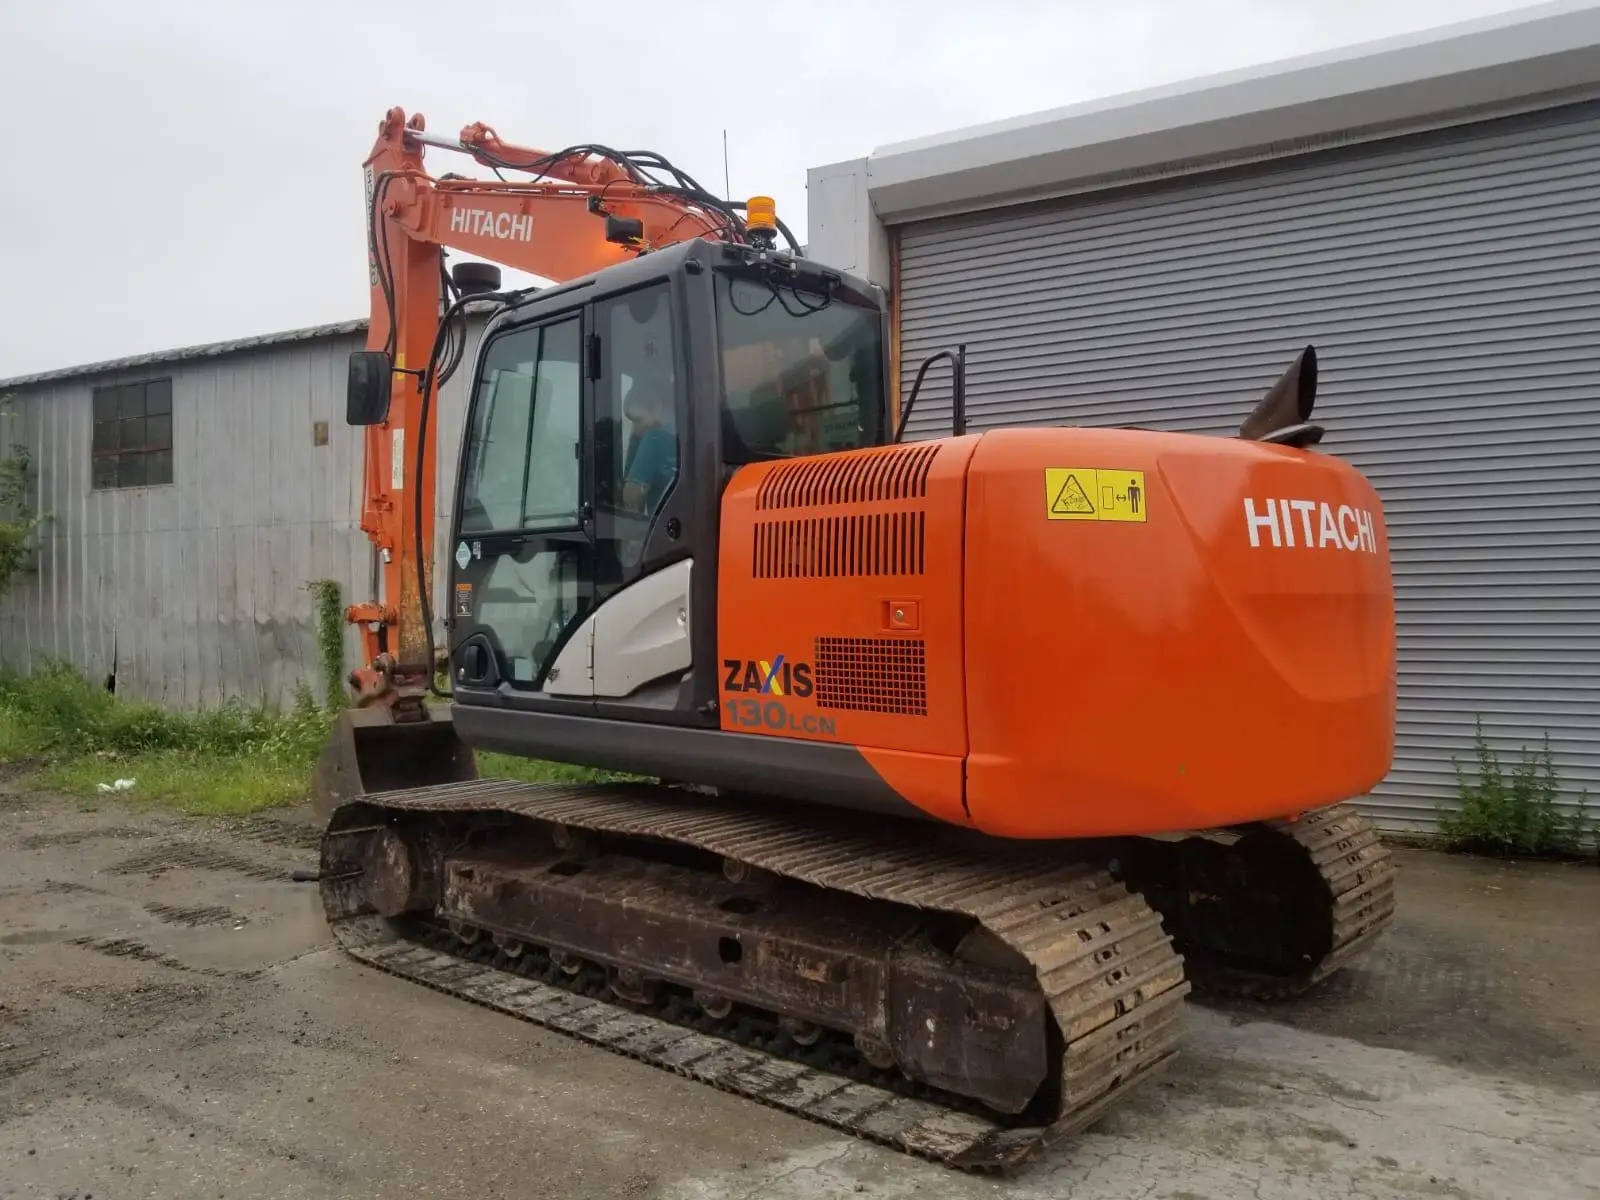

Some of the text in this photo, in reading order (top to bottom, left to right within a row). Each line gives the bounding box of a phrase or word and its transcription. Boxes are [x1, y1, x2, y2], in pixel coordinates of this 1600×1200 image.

[451, 207, 534, 242] HITACHI
[1244, 498, 1376, 554] HITACHI
[724, 655, 814, 697] ZAXIS
